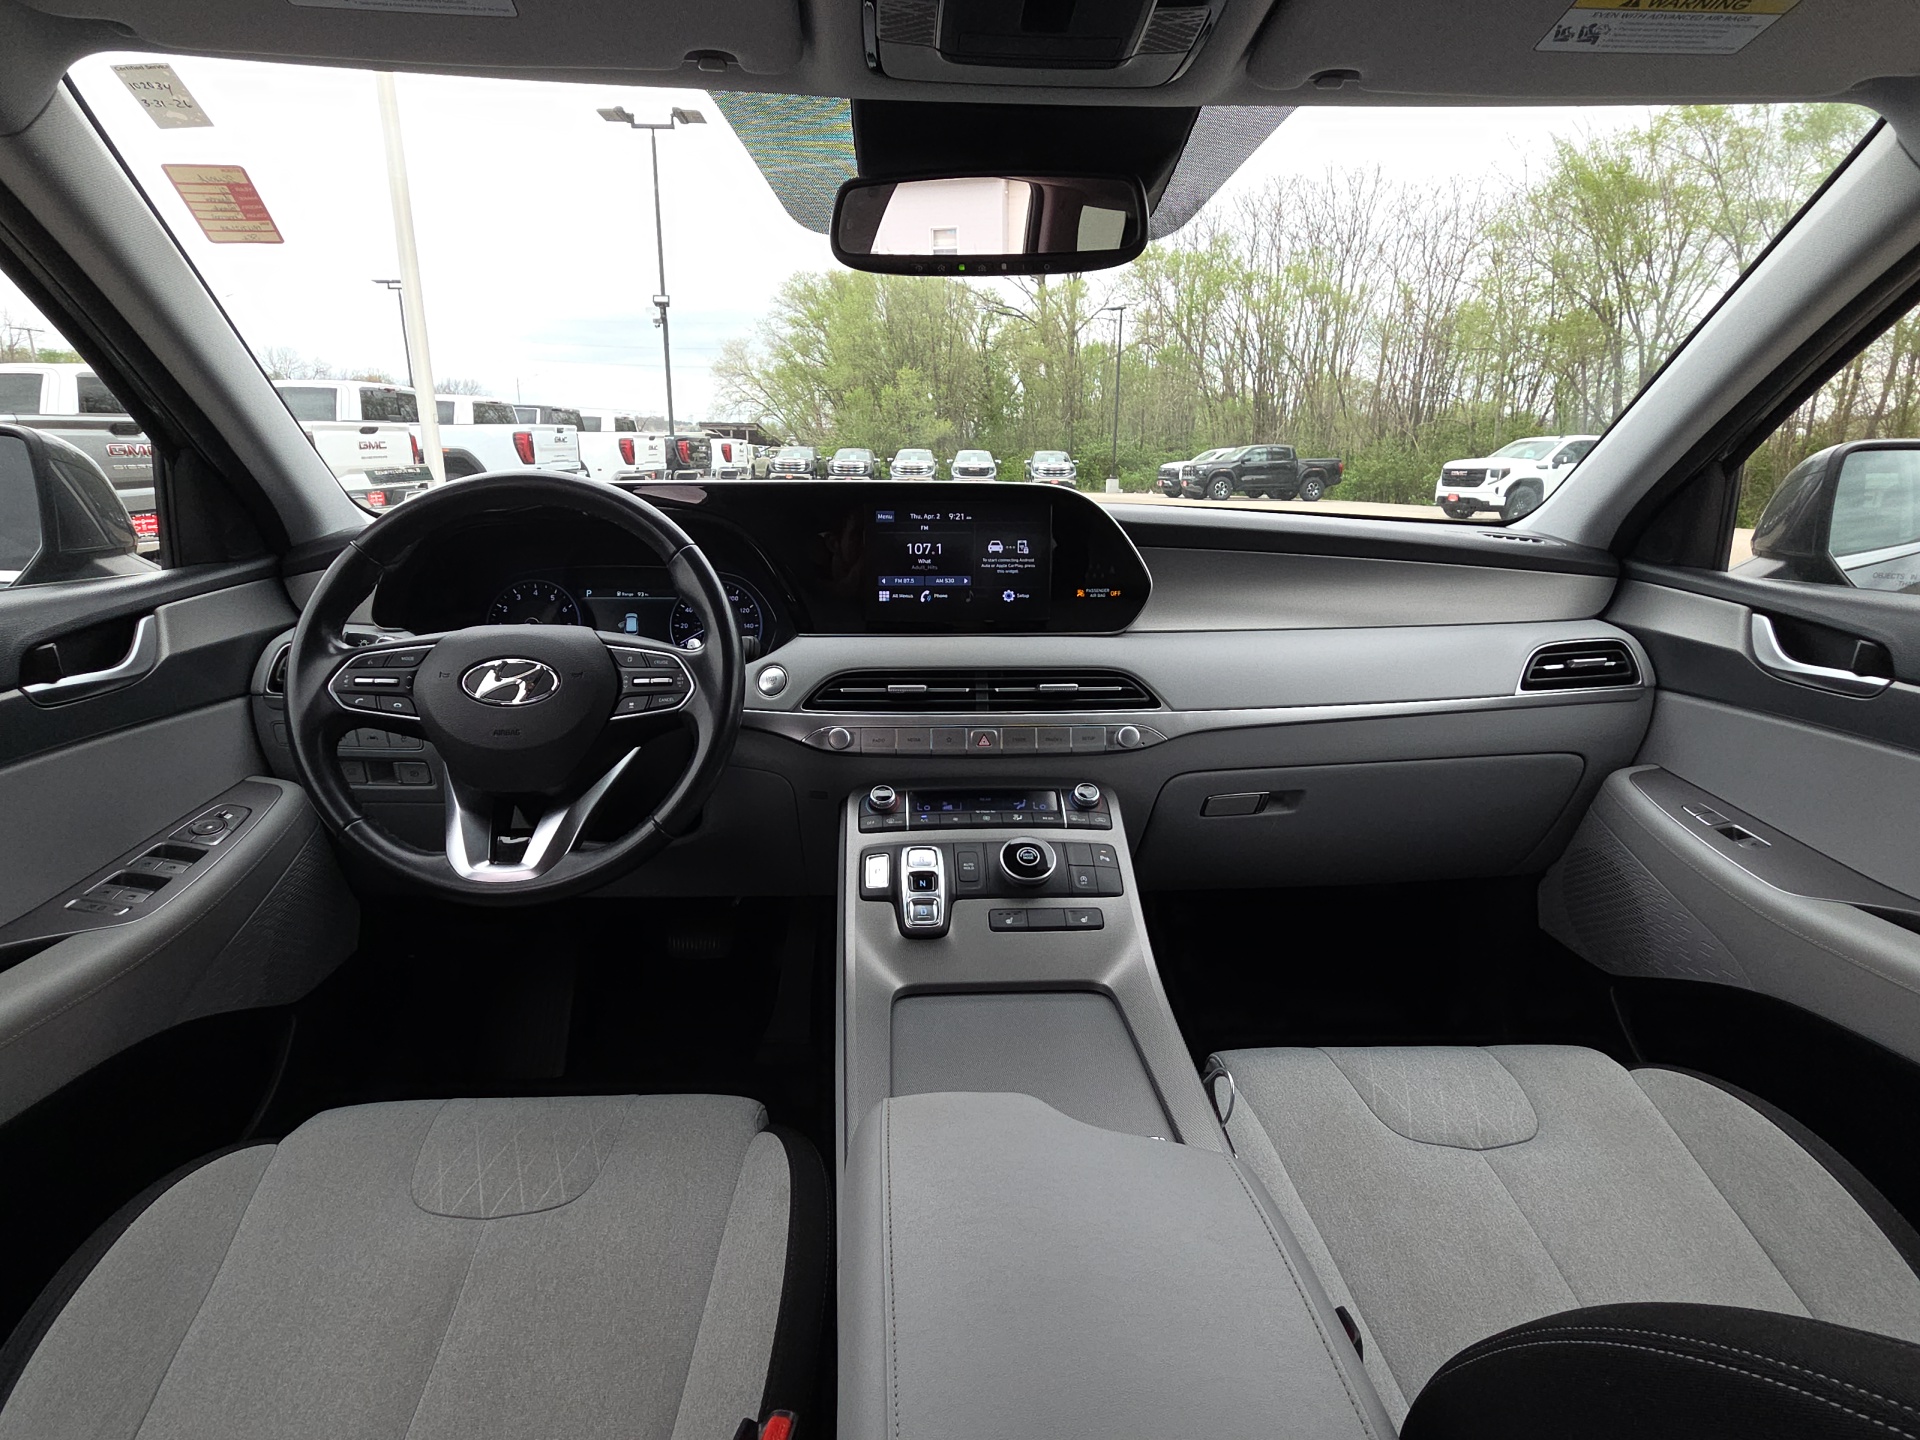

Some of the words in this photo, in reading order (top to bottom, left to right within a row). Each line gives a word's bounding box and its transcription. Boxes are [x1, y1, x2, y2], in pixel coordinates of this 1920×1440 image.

[1648, 0, 1750, 10] WARNING
[1620, 12, 1648, 20] WITH
[358, 441, 387, 450] GMC
[106, 443, 153, 457] GM
[923, 513, 935, 521] Apr.
[906, 543, 942, 555] 107.1
[586, 589, 592, 597] P
[493, 728, 521, 736] AIRBAG
